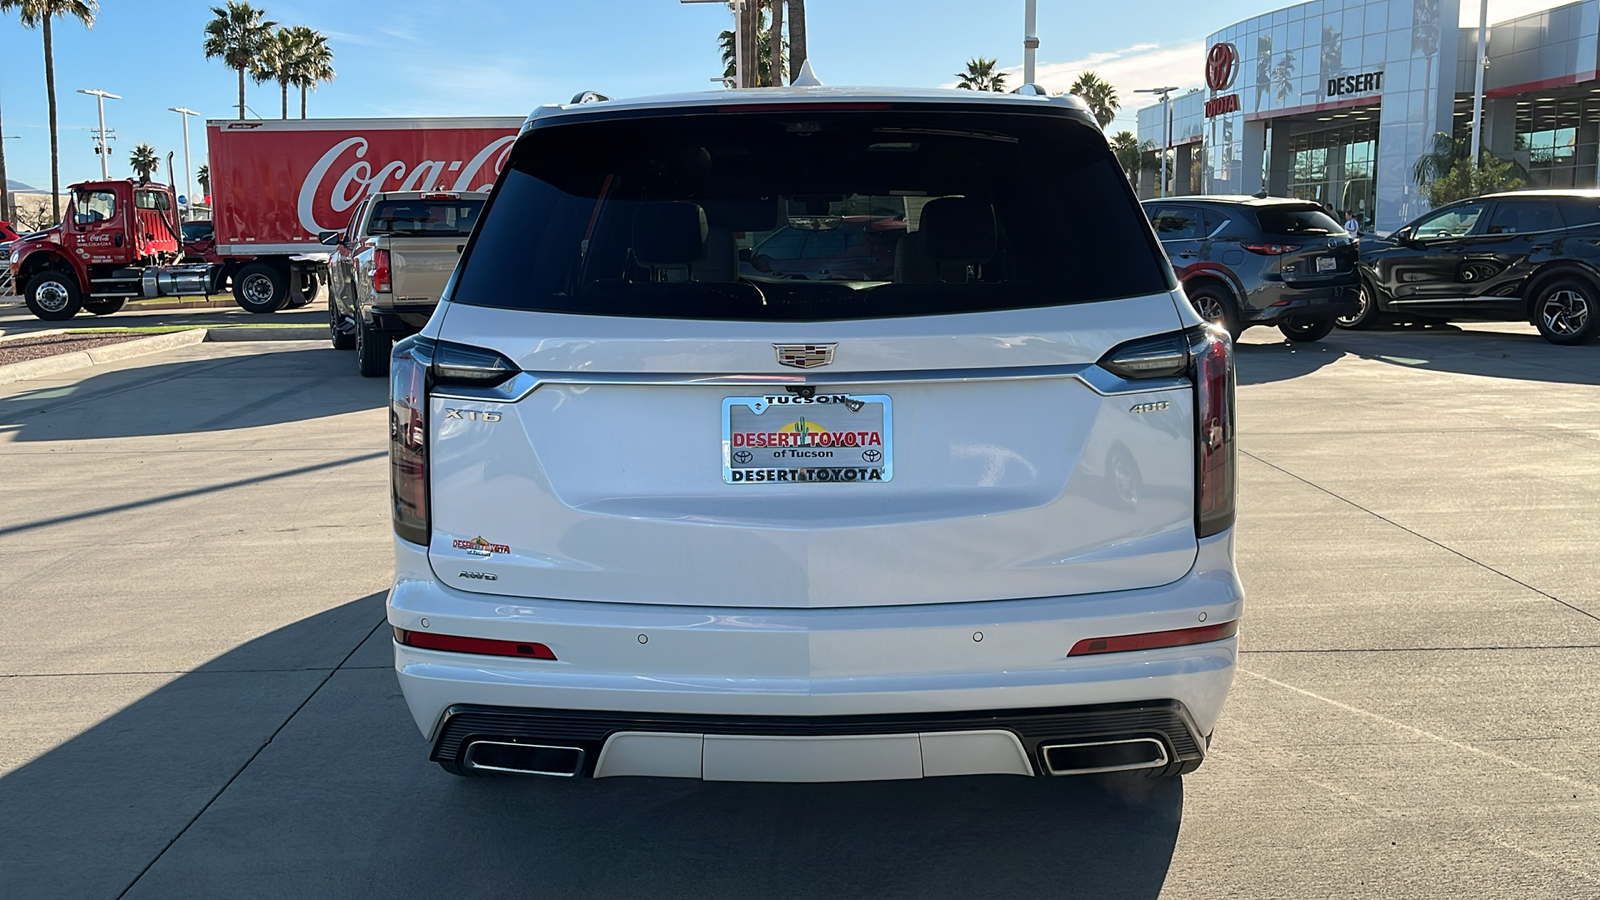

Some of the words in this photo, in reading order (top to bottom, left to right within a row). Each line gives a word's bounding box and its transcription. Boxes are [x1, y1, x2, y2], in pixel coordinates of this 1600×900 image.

[1327, 71, 1384, 97] DESERT
[1204, 95, 1235, 117] TOYOTA
[298, 136, 517, 235] Coca-C
[766, 395, 846, 404] TUCSON
[1129, 400, 1170, 413] 400
[445, 408, 503, 422] XT6
[733, 432, 801, 447] DESERT
[806, 432, 882, 446] TOYOTA
[773, 449, 786, 458] of
[789, 449, 834, 458] Tucson
[732, 469, 799, 482] DESERT
[805, 468, 882, 481] TOYOTA
[458, 570, 498, 581] AWD
